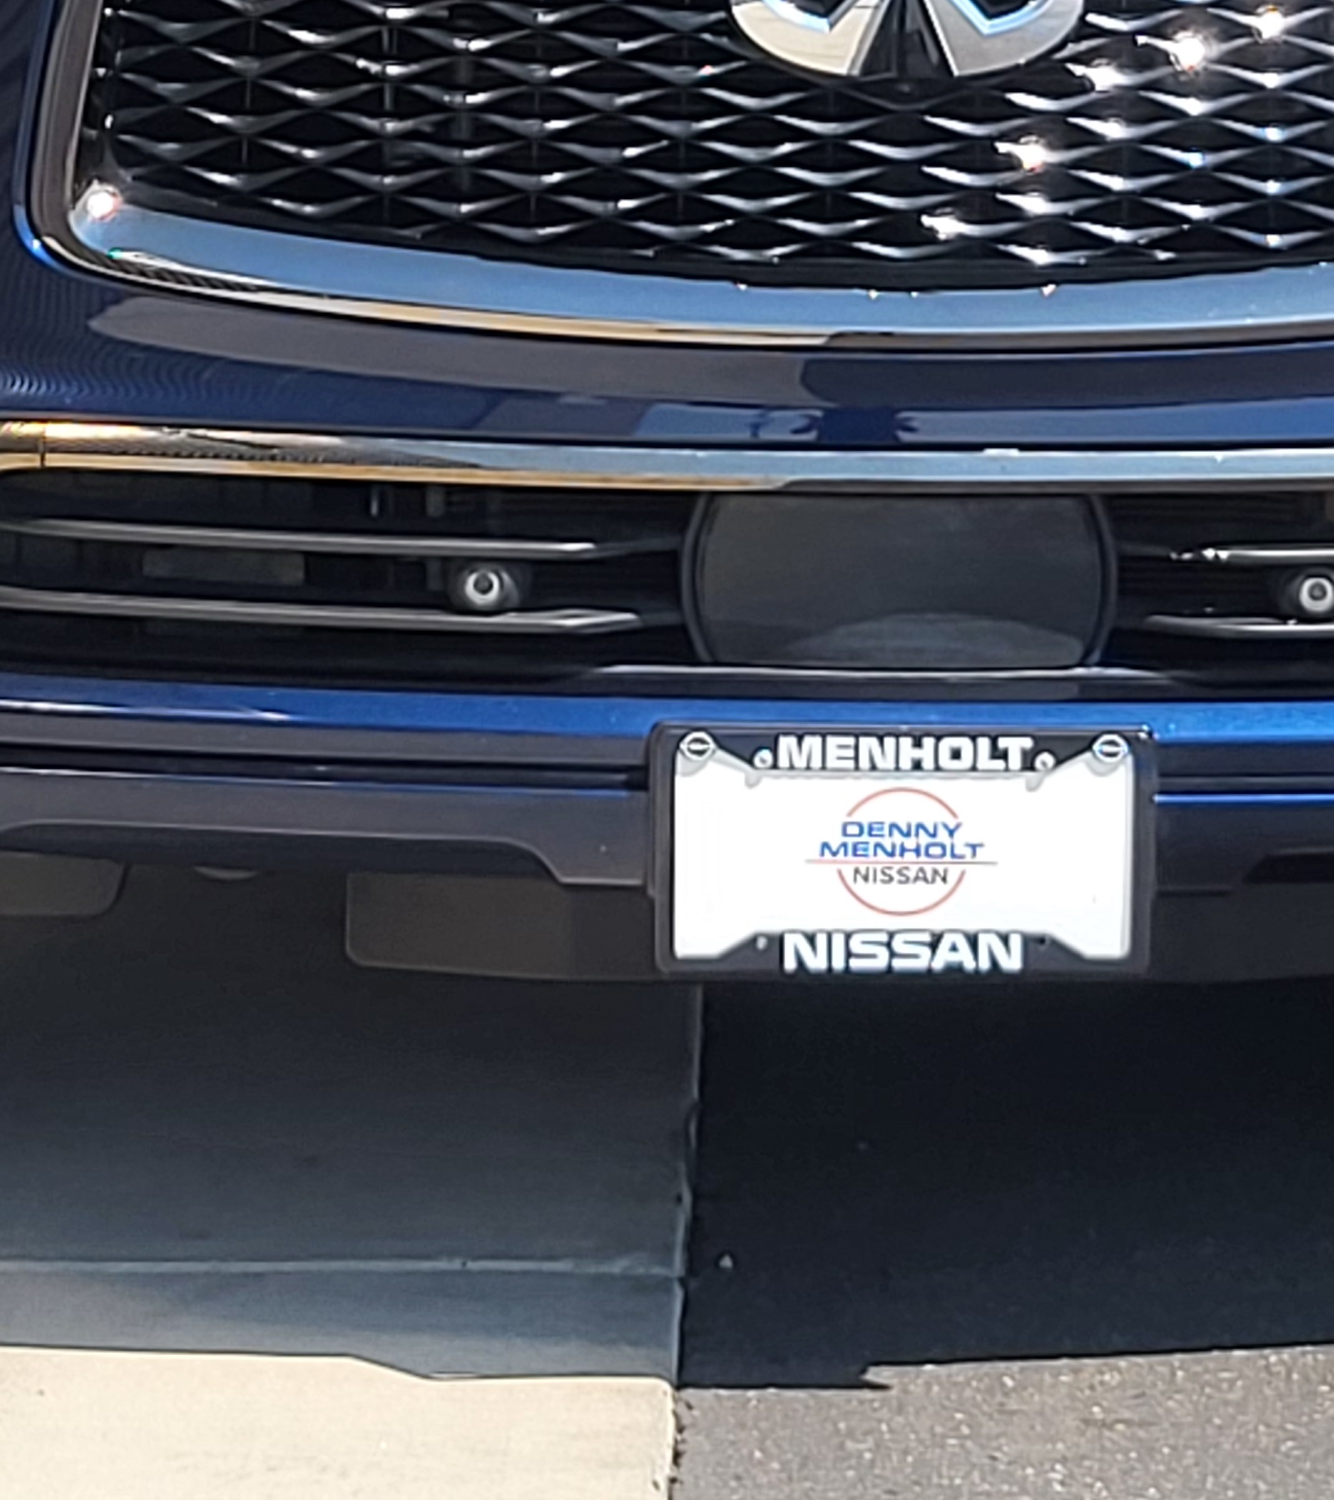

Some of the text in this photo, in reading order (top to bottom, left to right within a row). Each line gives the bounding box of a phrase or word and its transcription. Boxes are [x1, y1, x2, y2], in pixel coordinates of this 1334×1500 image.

[777, 735, 1033, 771] MENHOLT
[841, 820, 962, 840] DENNY
[819, 840, 985, 860] MENHOLT
[852, 866, 948, 885] NISSAN
[782, 932, 1024, 972] NISSAN
